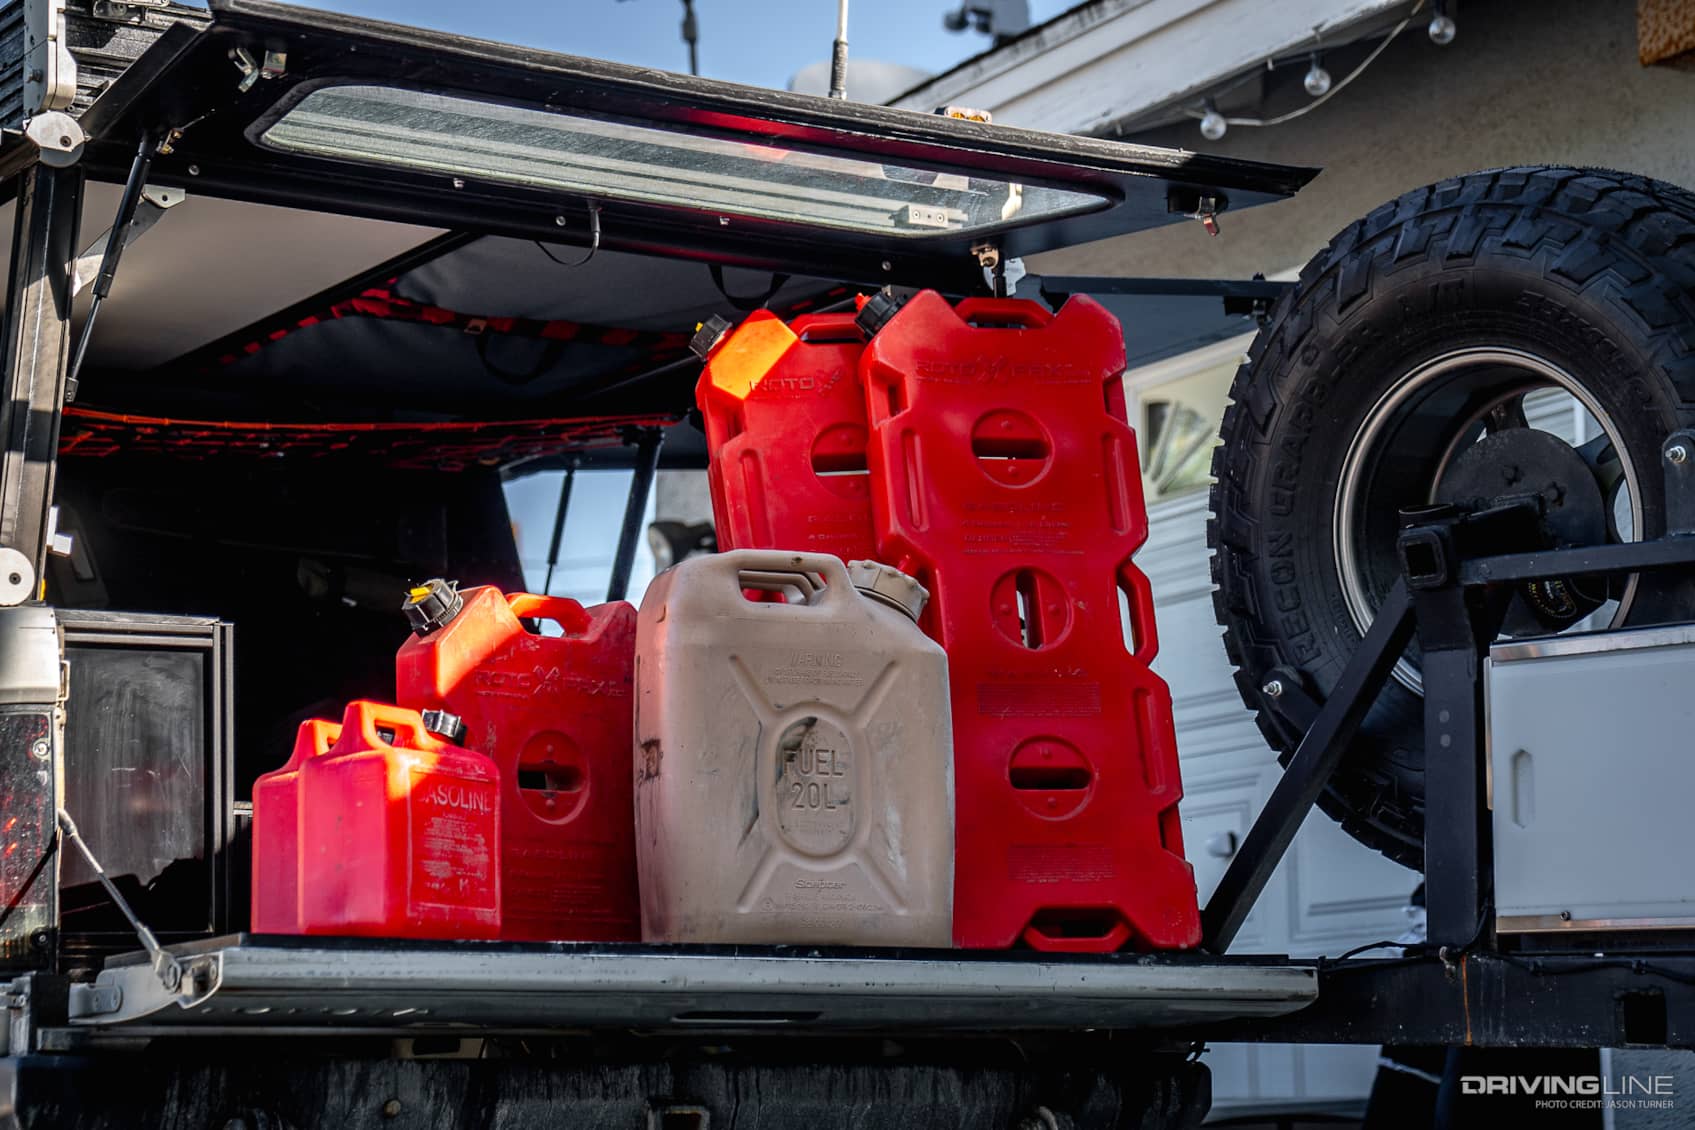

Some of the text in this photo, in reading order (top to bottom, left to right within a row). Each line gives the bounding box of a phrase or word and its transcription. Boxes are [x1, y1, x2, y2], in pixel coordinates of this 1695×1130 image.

[1268, 531, 1322, 664] RECON
[783, 747, 844, 777] FUEL
[417, 784, 491, 814] ASOLINE
[791, 782, 837, 809] 20L
